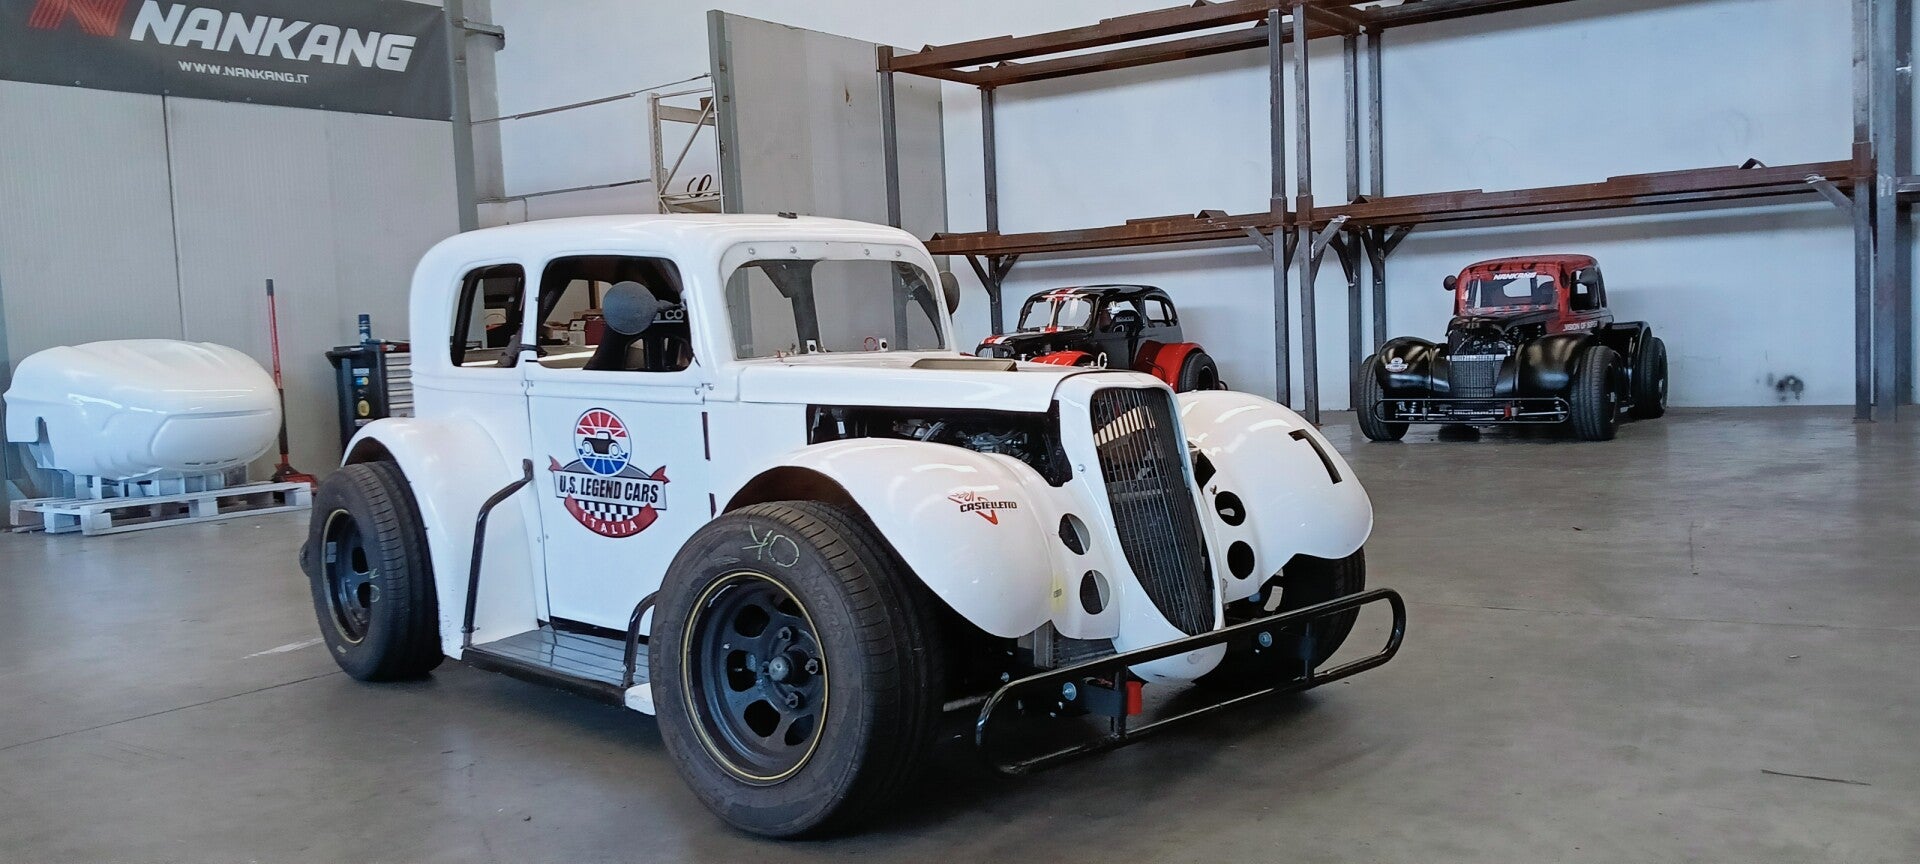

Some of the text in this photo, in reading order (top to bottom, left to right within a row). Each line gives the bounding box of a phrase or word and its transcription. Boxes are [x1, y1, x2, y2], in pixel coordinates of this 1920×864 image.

[129, 0, 417, 72] NANKANG
[178, 60, 309, 83] WWW.NANKANG.IT
[560, 475, 659, 504] U.S. LEGEND CARS
[960, 501, 1018, 513] CASTELLETTO
[582, 512, 638, 534] ITALIA
